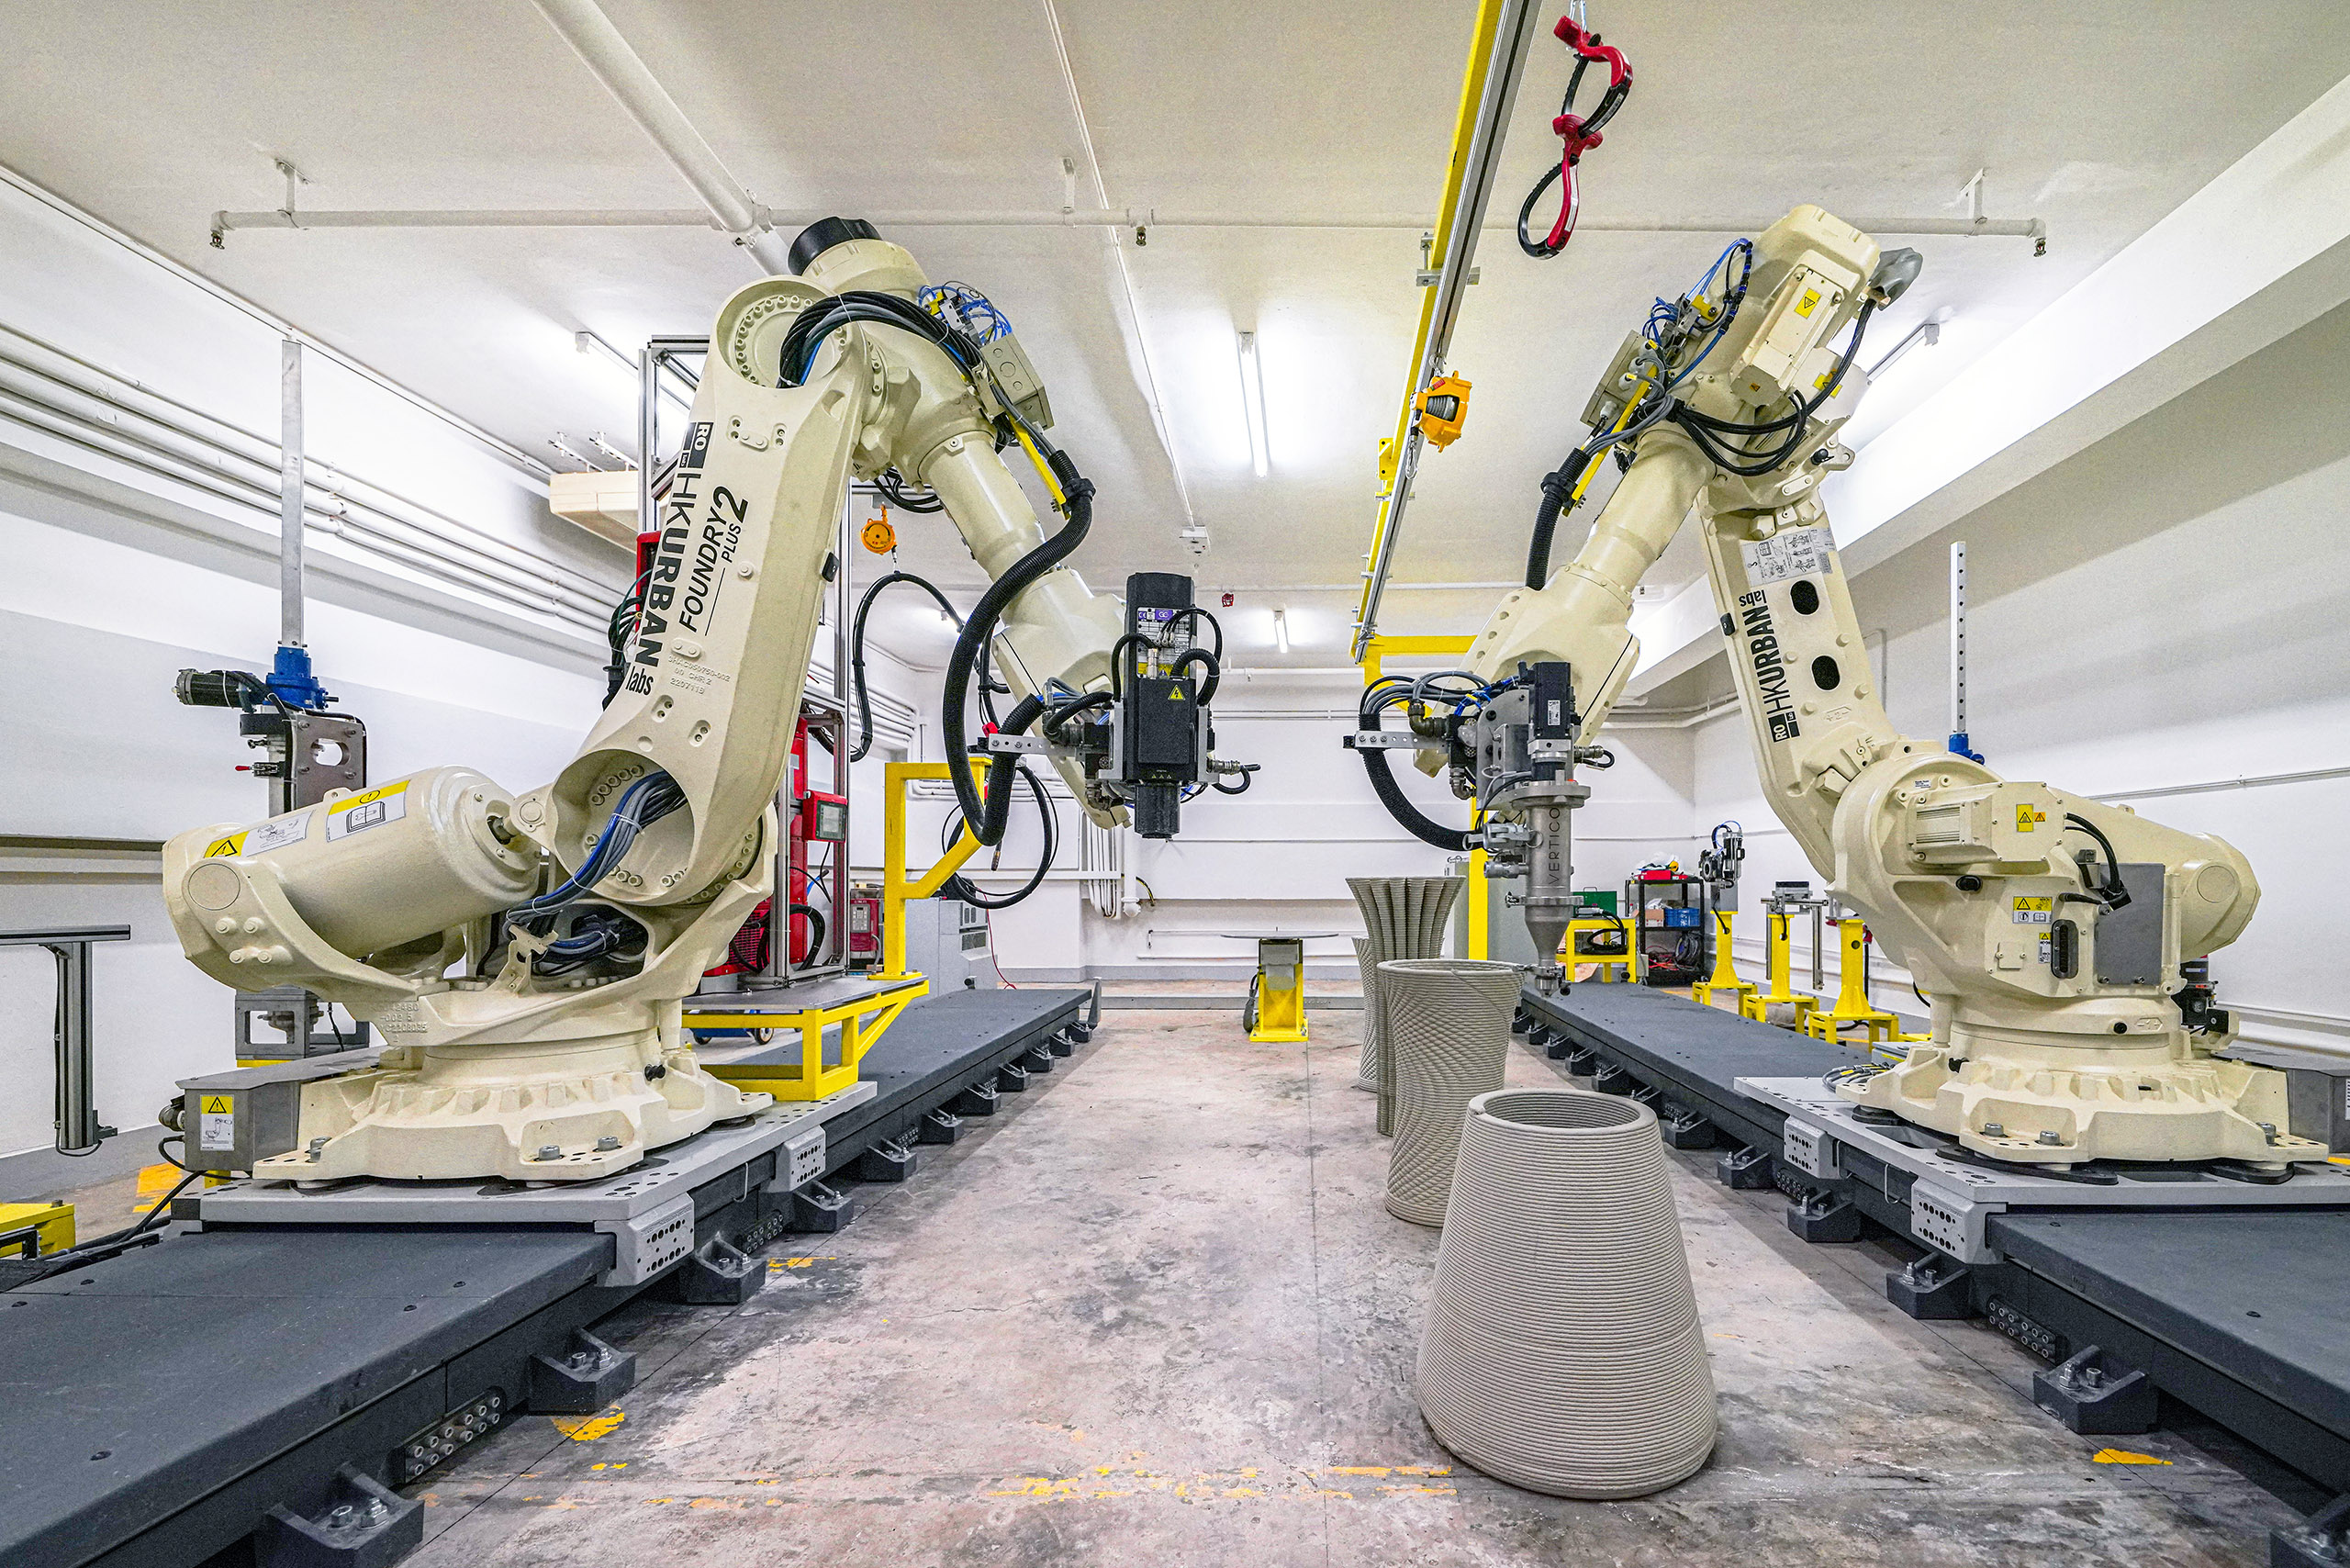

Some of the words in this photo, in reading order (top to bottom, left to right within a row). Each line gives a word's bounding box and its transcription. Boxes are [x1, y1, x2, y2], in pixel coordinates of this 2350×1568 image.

[695, 424, 711, 451] RO
[679, 507, 727, 633] FOUNDRY
[712, 486, 748, 523] 2
[721, 523, 742, 563] PLUS
[634, 472, 701, 667] HKURBAN
[1739, 589, 1767, 608] labs
[1741, 605, 1793, 714] HKURBAN
[625, 665, 655, 696] labs
[1774, 724, 1787, 741] RO
[1549, 808, 1560, 885] VERTICO
